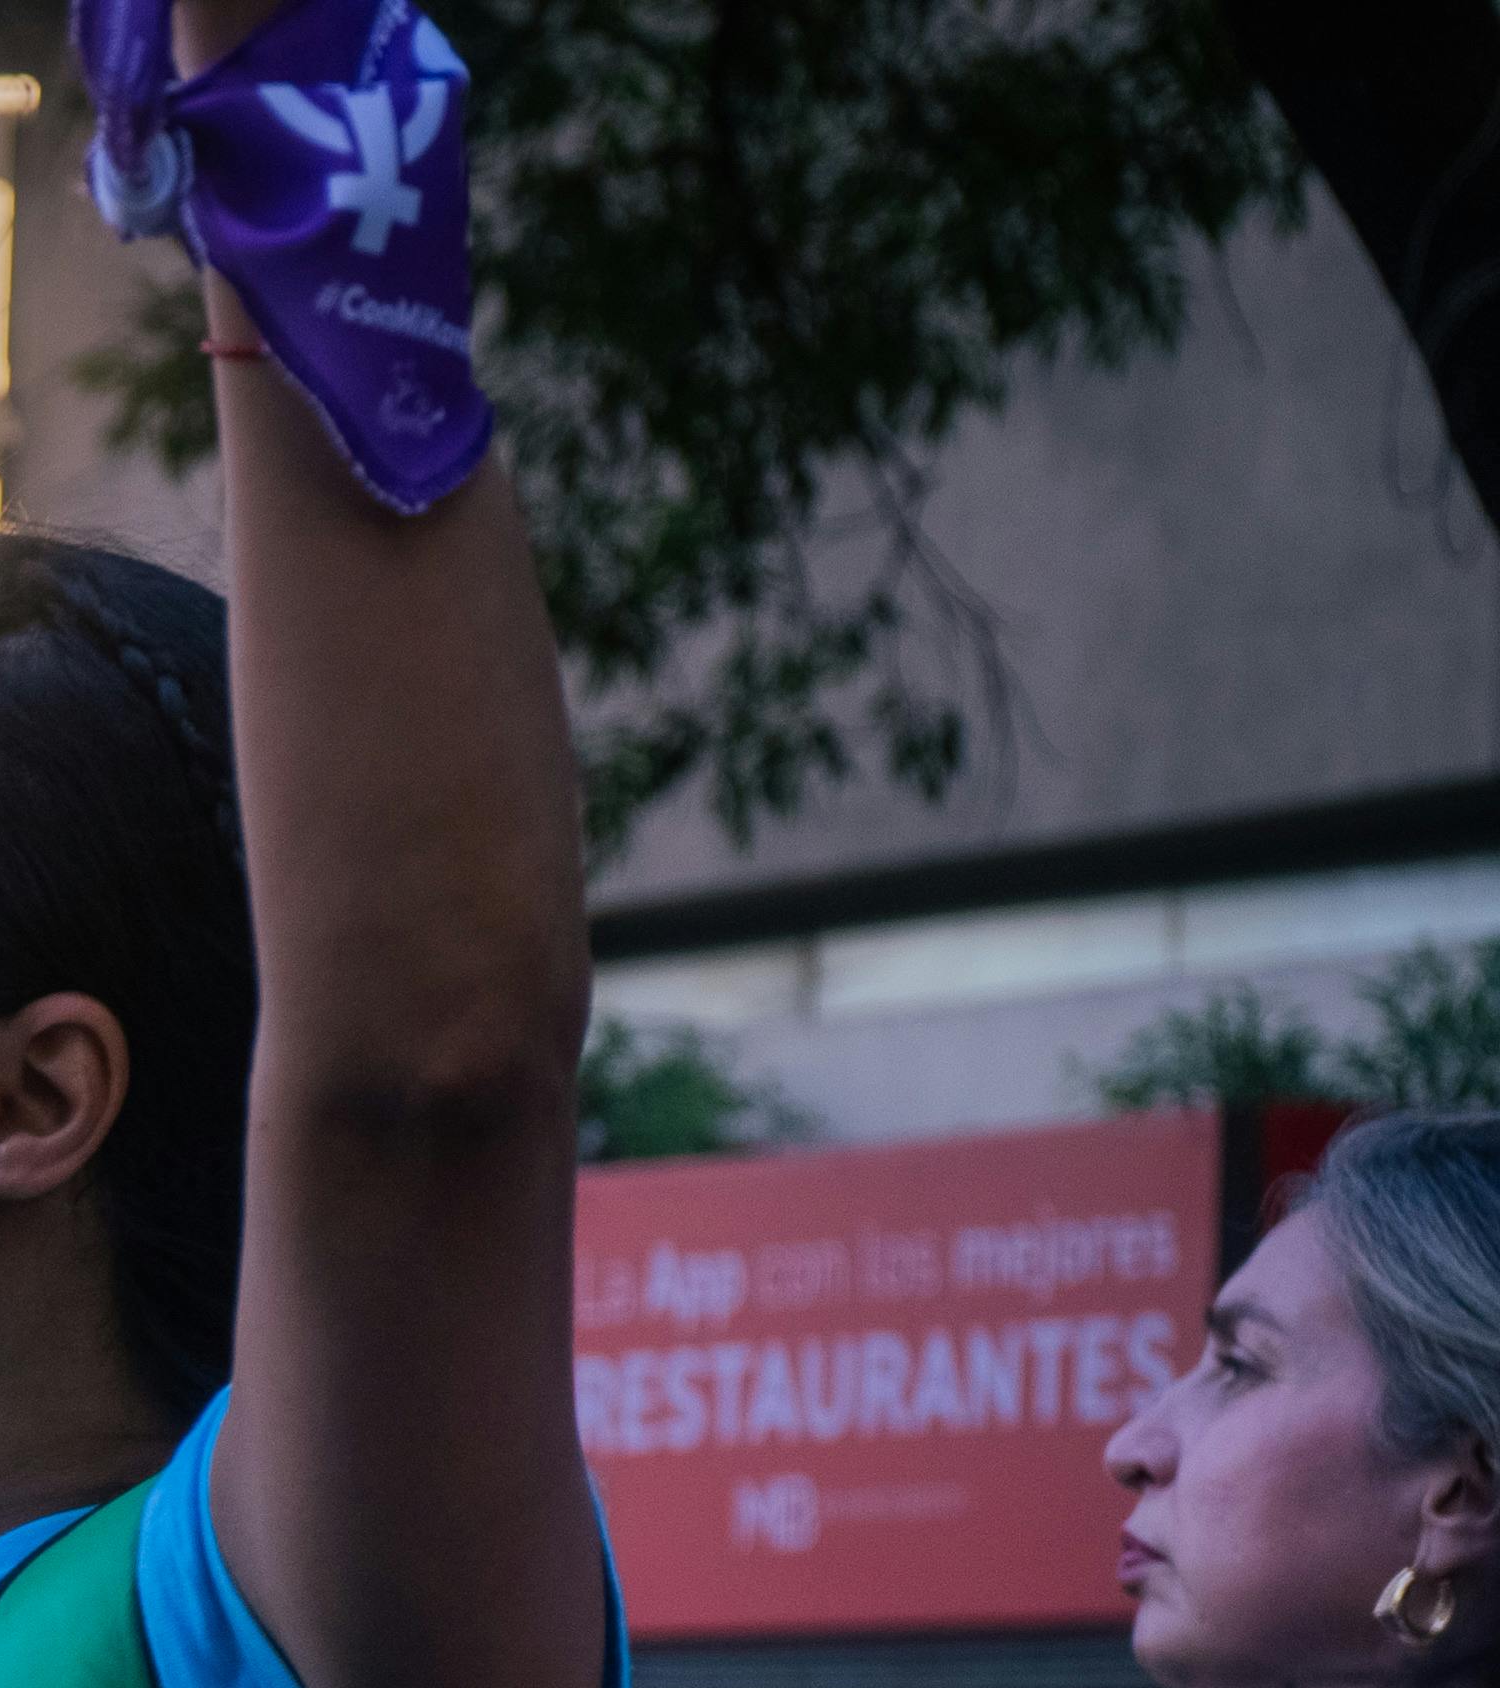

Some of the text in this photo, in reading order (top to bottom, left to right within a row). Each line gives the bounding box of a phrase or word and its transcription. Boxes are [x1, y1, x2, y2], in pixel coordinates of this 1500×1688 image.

[644, 1242, 747, 1332] App
[750, 1242, 850, 1308] con
[954, 1206, 1176, 1304] mejores
[576, 1314, 1173, 1450] RESTAURANTES
